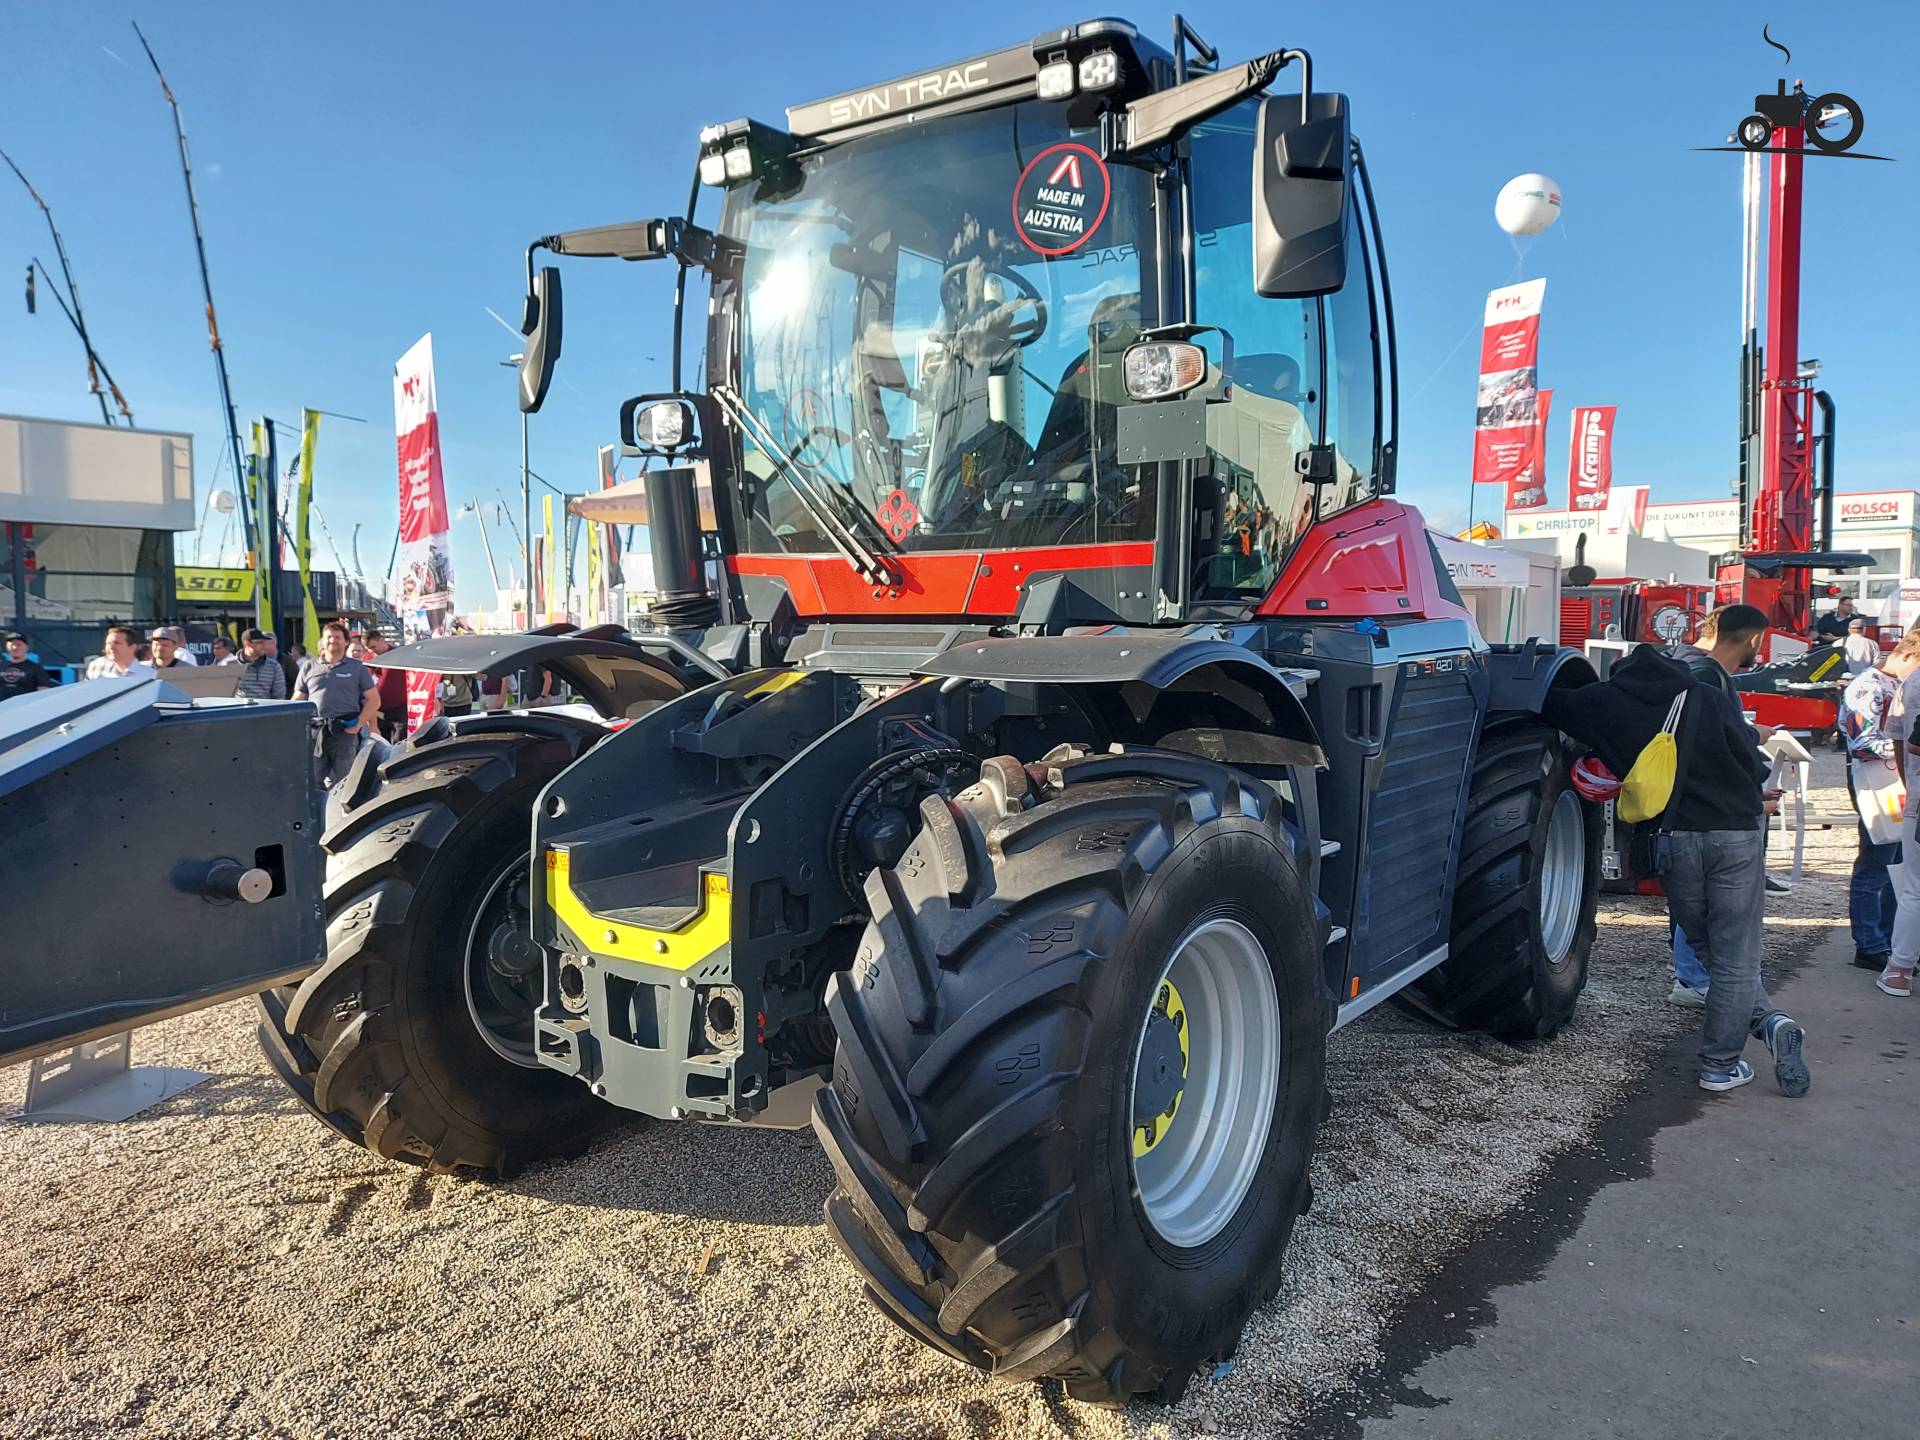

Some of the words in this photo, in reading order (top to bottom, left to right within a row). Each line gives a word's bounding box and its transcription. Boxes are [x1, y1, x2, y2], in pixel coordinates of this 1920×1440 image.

[830, 87, 891, 124] SYN
[897, 61, 989, 104] TRAC
[1037, 187, 1070, 204] MADE
[1072, 192, 1086, 207] IN
[1023, 208, 1084, 233] AUSTRIA
[1663, 511, 1705, 520] ZUKUNFT
[1708, 509, 1725, 518] DER
[1447, 563, 1468, 577] SYN
[1470, 564, 1497, 578] TRAC
[1424, 659, 1453, 674] ST420
